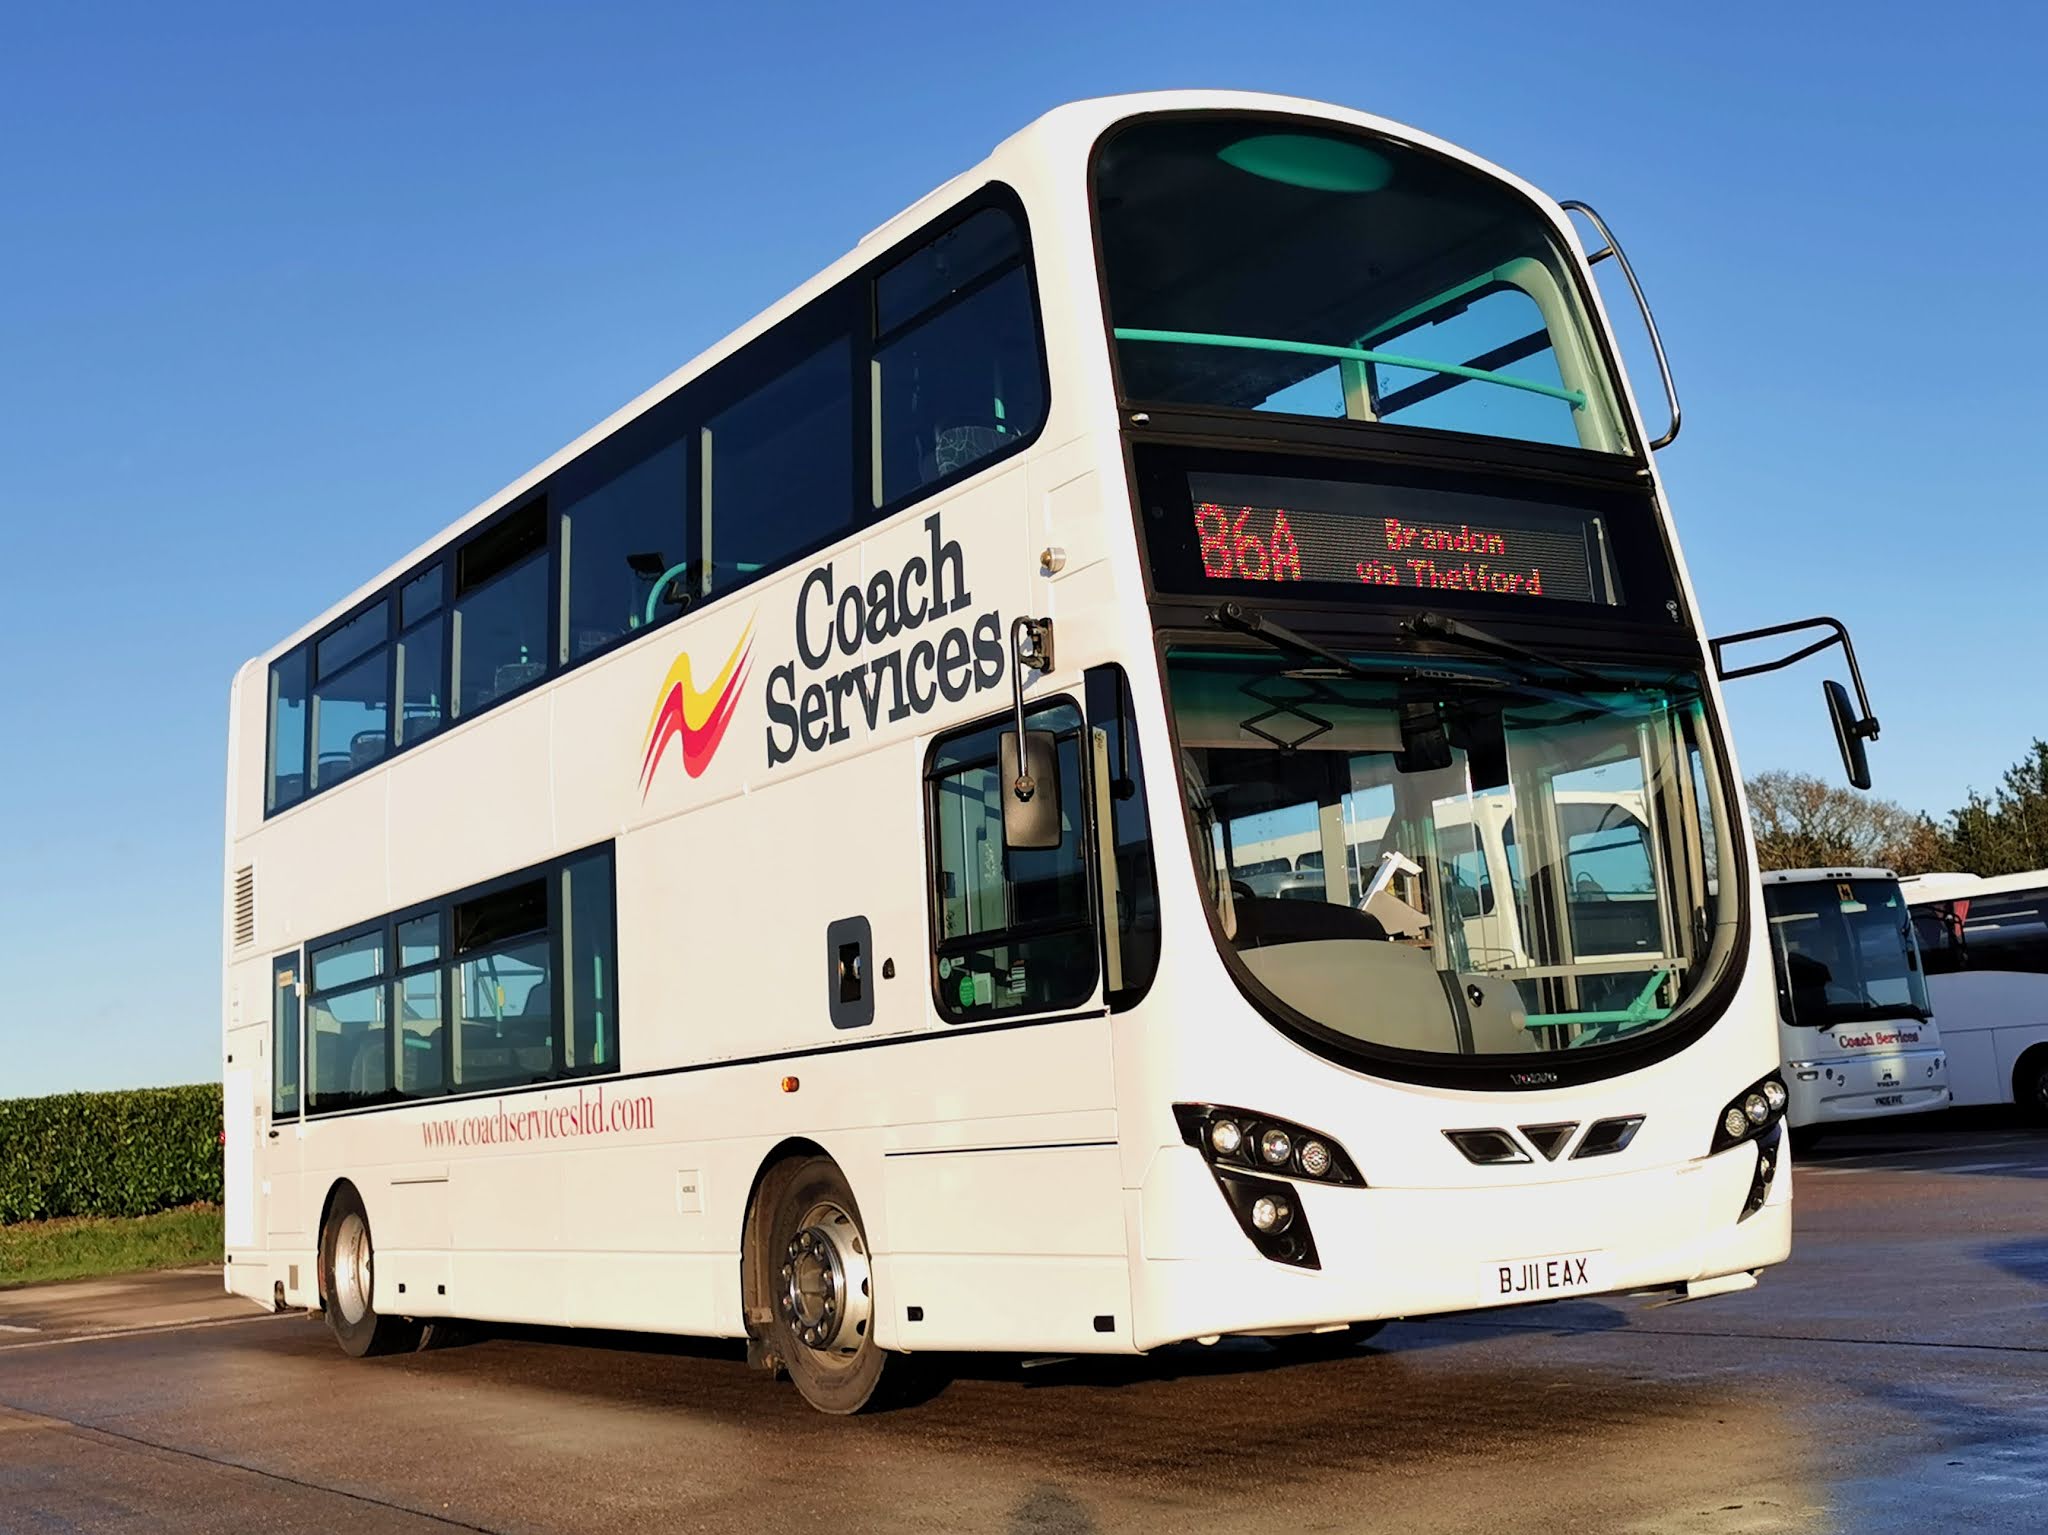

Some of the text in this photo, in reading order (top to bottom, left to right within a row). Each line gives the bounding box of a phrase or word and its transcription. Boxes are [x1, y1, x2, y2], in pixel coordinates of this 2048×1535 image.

[1384, 517, 1504, 554] Brandon
[796, 512, 971, 669] Coach
[1356, 558, 1543, 595] via Thetford
[766, 609, 1005, 768] Services
[1839, 1029, 1919, 1048] Coach Services
[422, 1086, 655, 1149] www.coachservicesltd.com
[1499, 1257, 1588, 1294] BJ11 EAX
